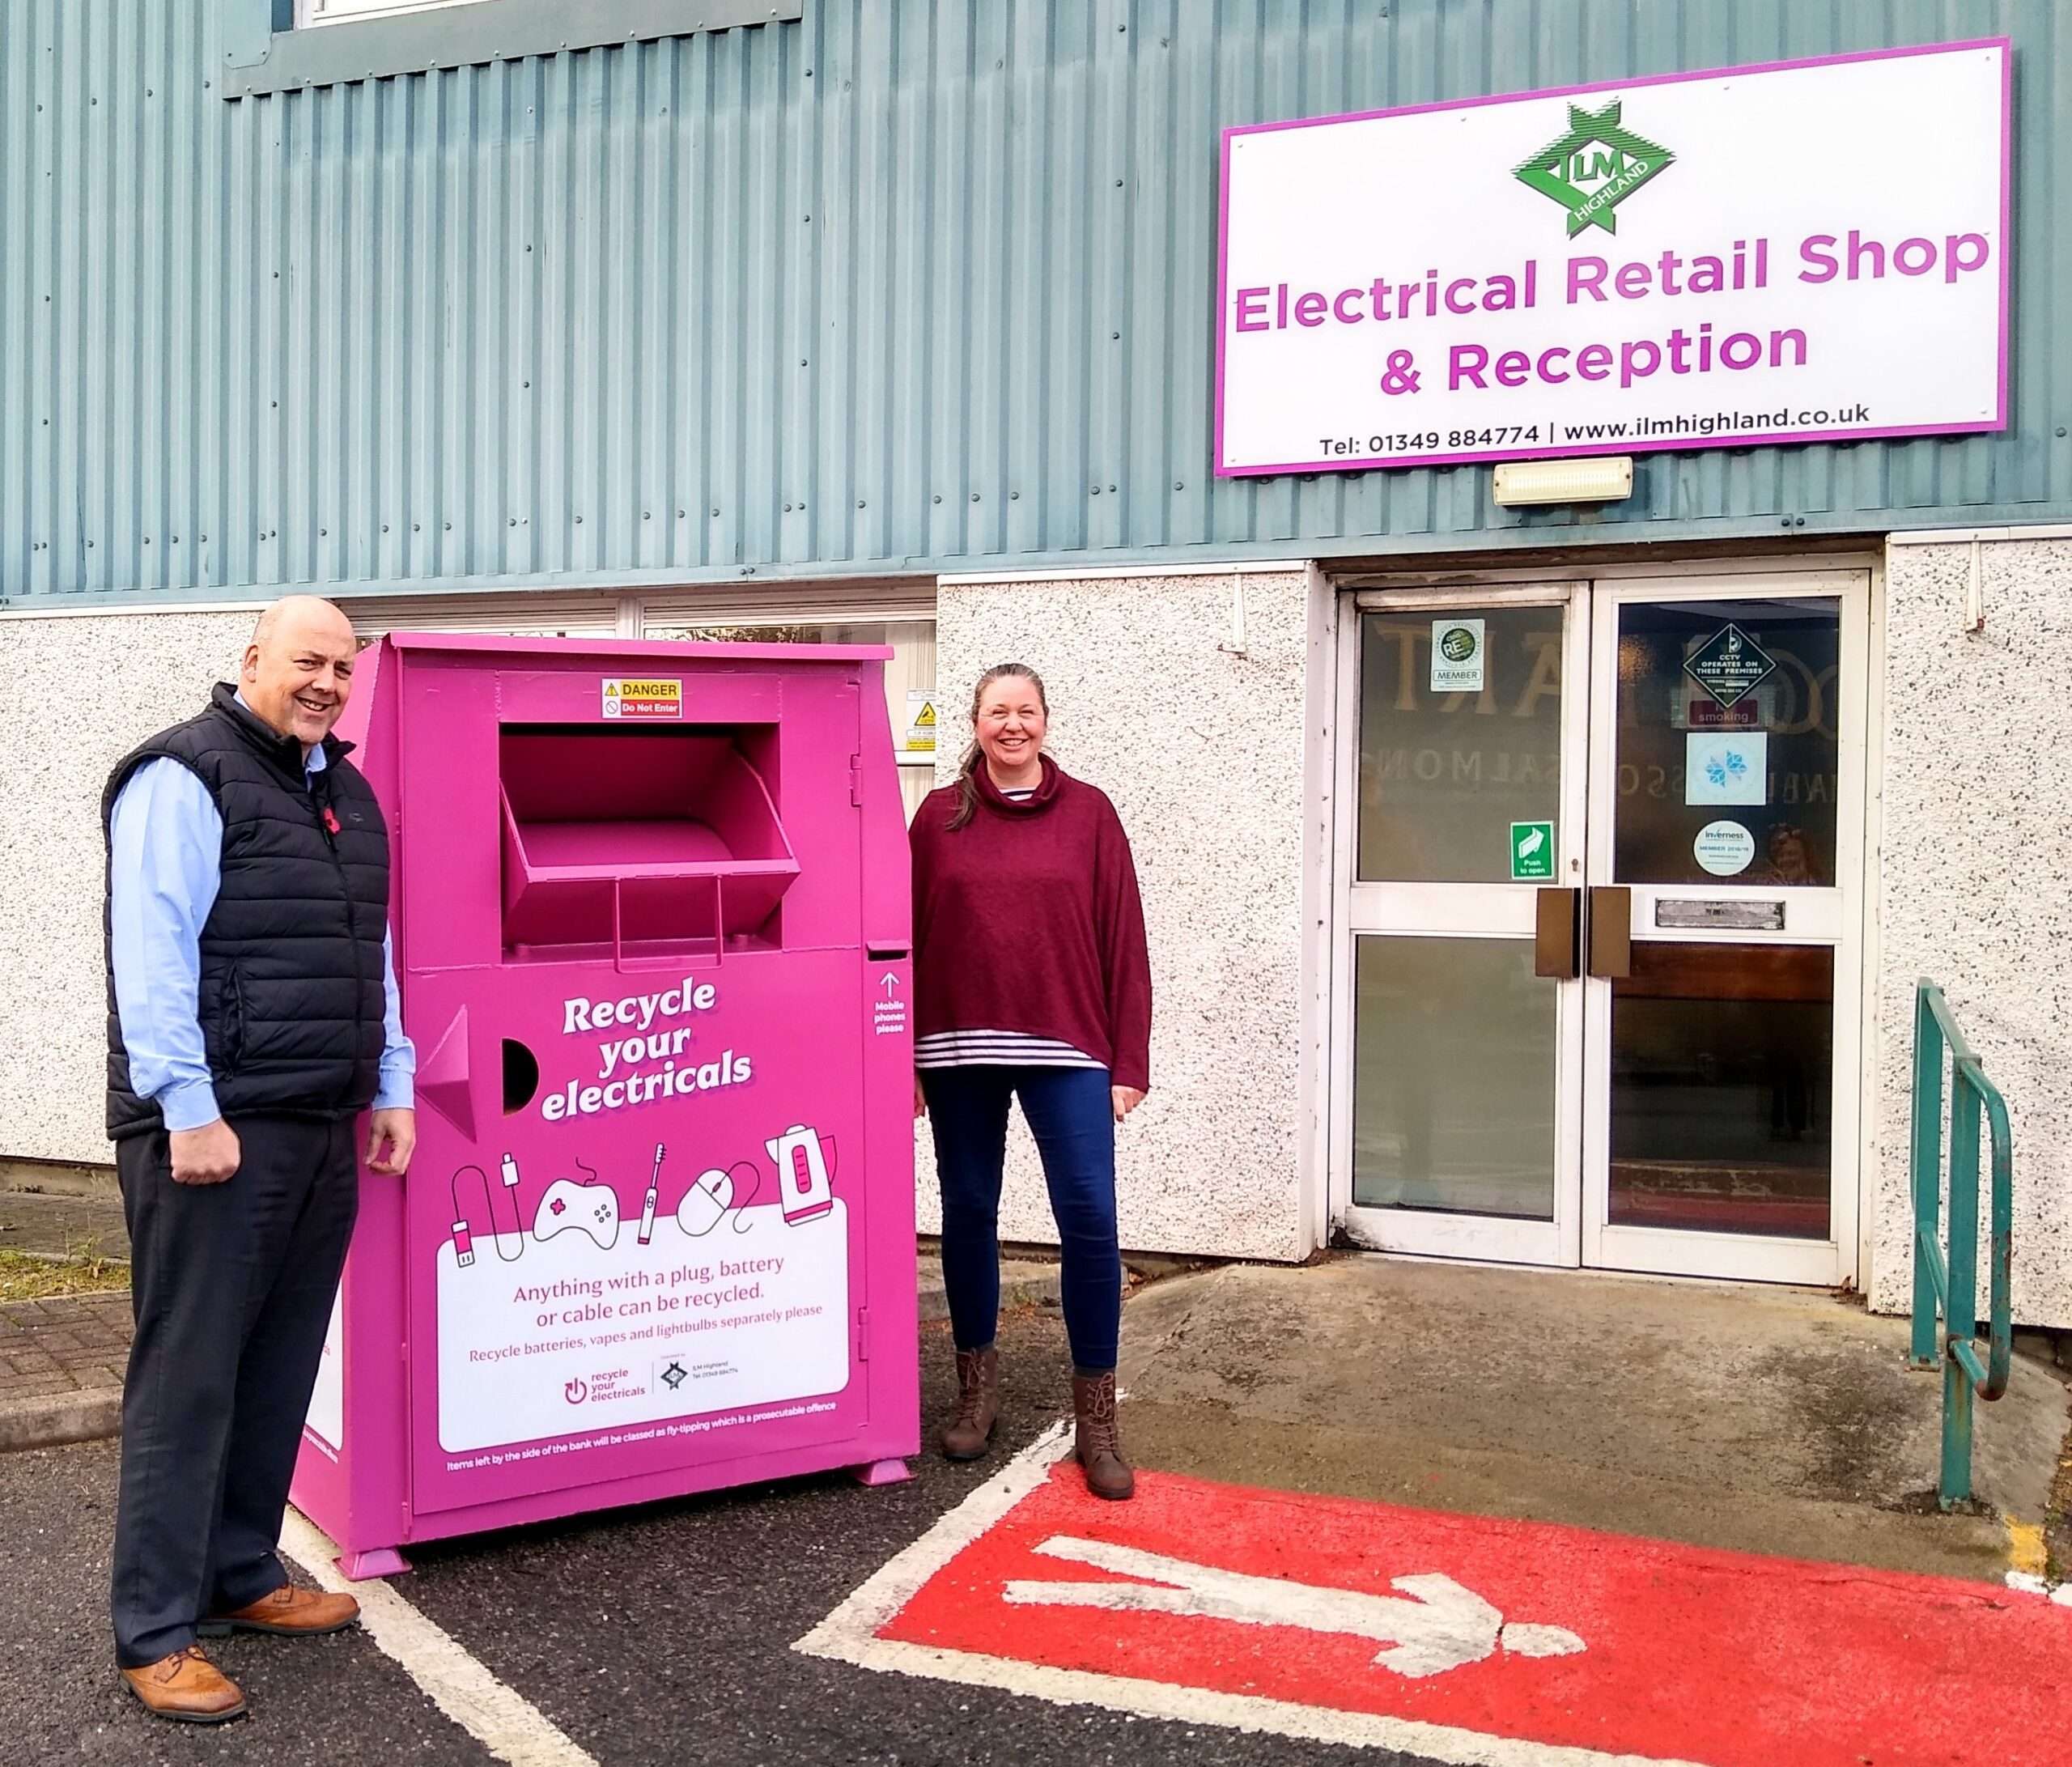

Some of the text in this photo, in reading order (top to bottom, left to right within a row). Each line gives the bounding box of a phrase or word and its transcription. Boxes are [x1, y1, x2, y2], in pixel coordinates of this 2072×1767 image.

[1559, 148, 1624, 182] ILM
[1573, 160, 1650, 222] HIGHLAND
[1236, 230, 1989, 333] Electrical Retail Shop
[1380, 323, 1808, 395] & Reception
[1319, 437, 1360, 455] Tel:
[1369, 431, 1440, 452] 01349
[1448, 425, 1539, 447] 884774
[1564, 403, 1870, 440] www.ilmhighland.co.uk
[622, 684, 677, 695] DANGER
[1437, 671, 1477, 679] MEMBER
[622, 703, 678, 712] Do Not Enter
[1699, 711, 1748, 723] smoking
[563, 976, 715, 1034] Recycle
[874, 1012, 906, 1024] phones
[875, 1000, 905, 1011] Mobile
[876, 1024, 905, 1035] please
[598, 1026, 692, 1079] your
[541, 1049, 752, 1122] electricals
[513, 1256, 784, 1305] Anything with a plug, battery
[537, 1281, 765, 1327] or cable can be recycled.
[469, 1304, 823, 1362] Recycle batteries, vapes and lightbulbs separately please
[591, 1368, 629, 1382] recycle
[591, 1380, 616, 1394] your
[591, 1386, 646, 1402] electricals
[447, 1401, 836, 1472] Items left by the side of the bank will be classed as fly-tipping which is a prosecutable offence
